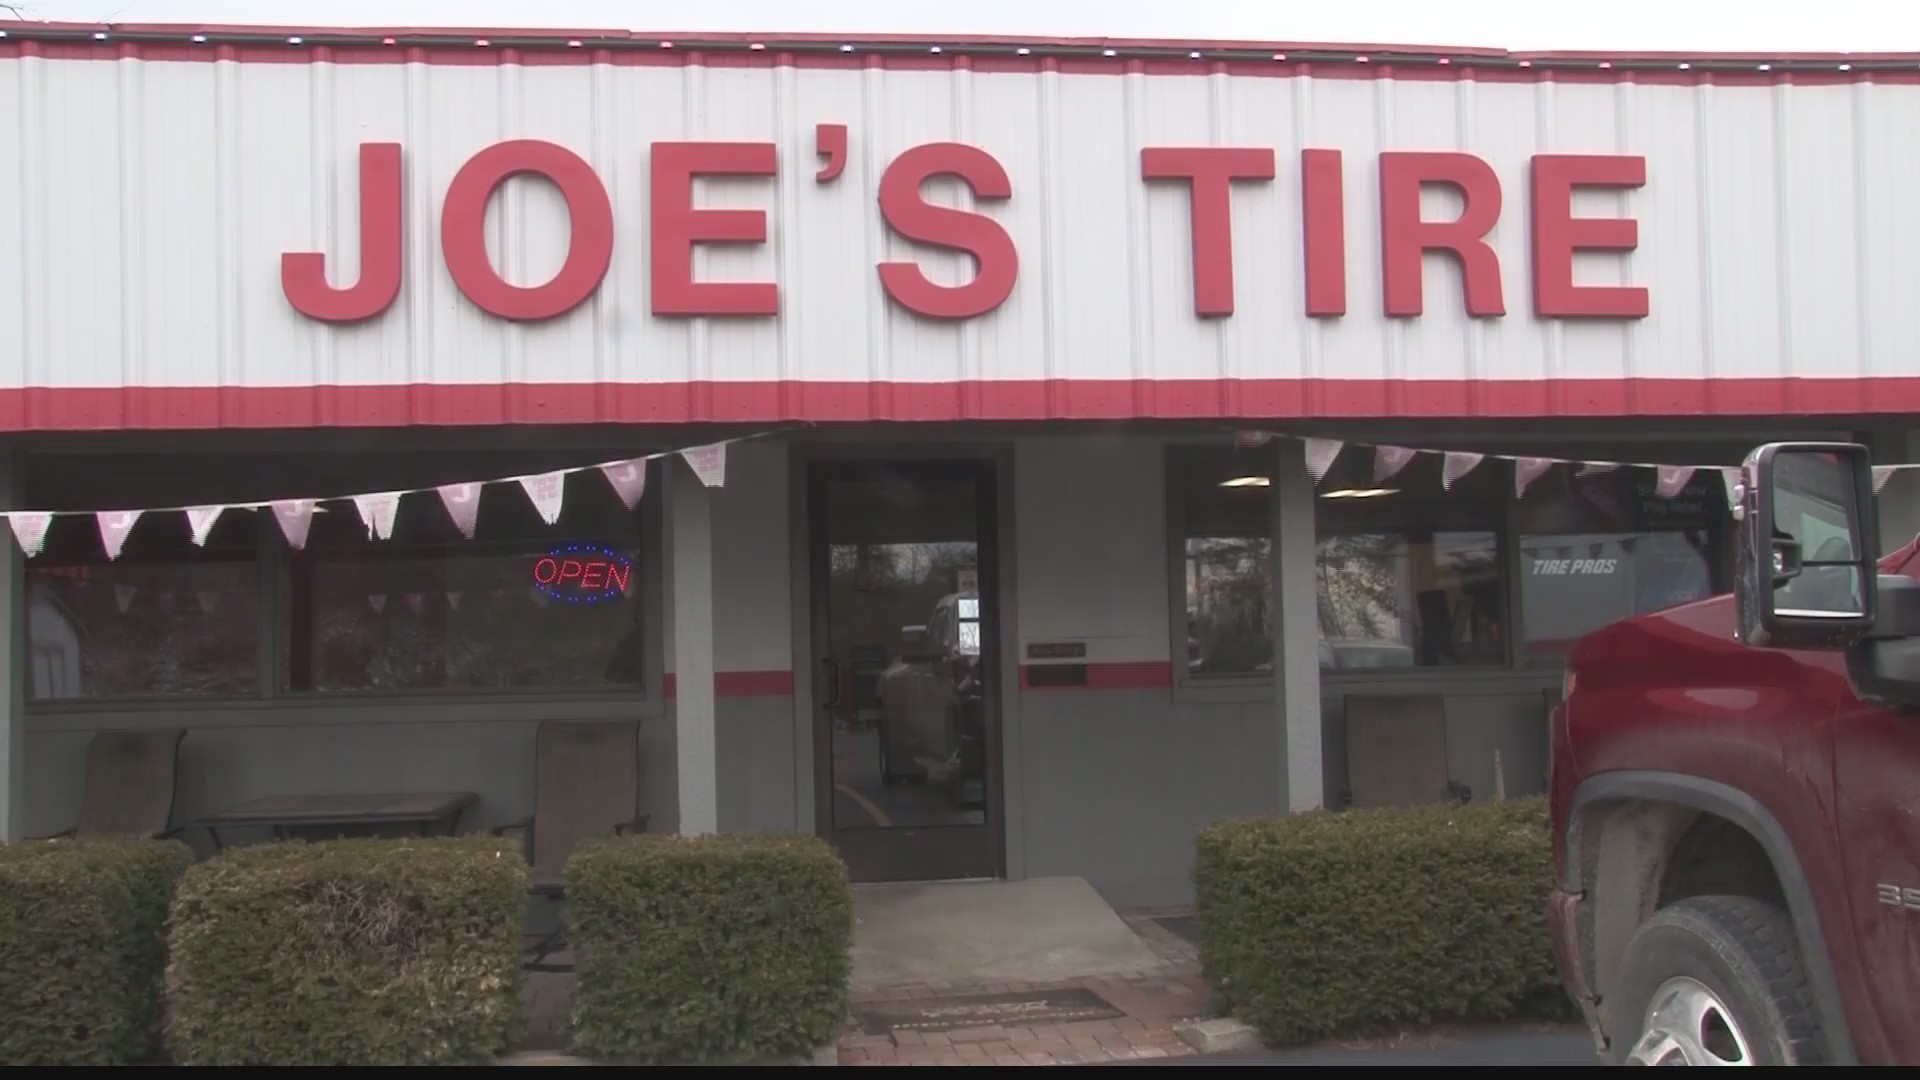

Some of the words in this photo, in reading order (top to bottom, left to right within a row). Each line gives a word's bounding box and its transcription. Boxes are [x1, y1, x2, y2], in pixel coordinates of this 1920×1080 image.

[281, 123, 1018, 322] JOE'S
[1142, 147, 1650, 319] TIRE
[534, 558, 632, 592] OPEN
[1532, 559, 1570, 575] TIRE
[1570, 559, 1618, 575] PROS
